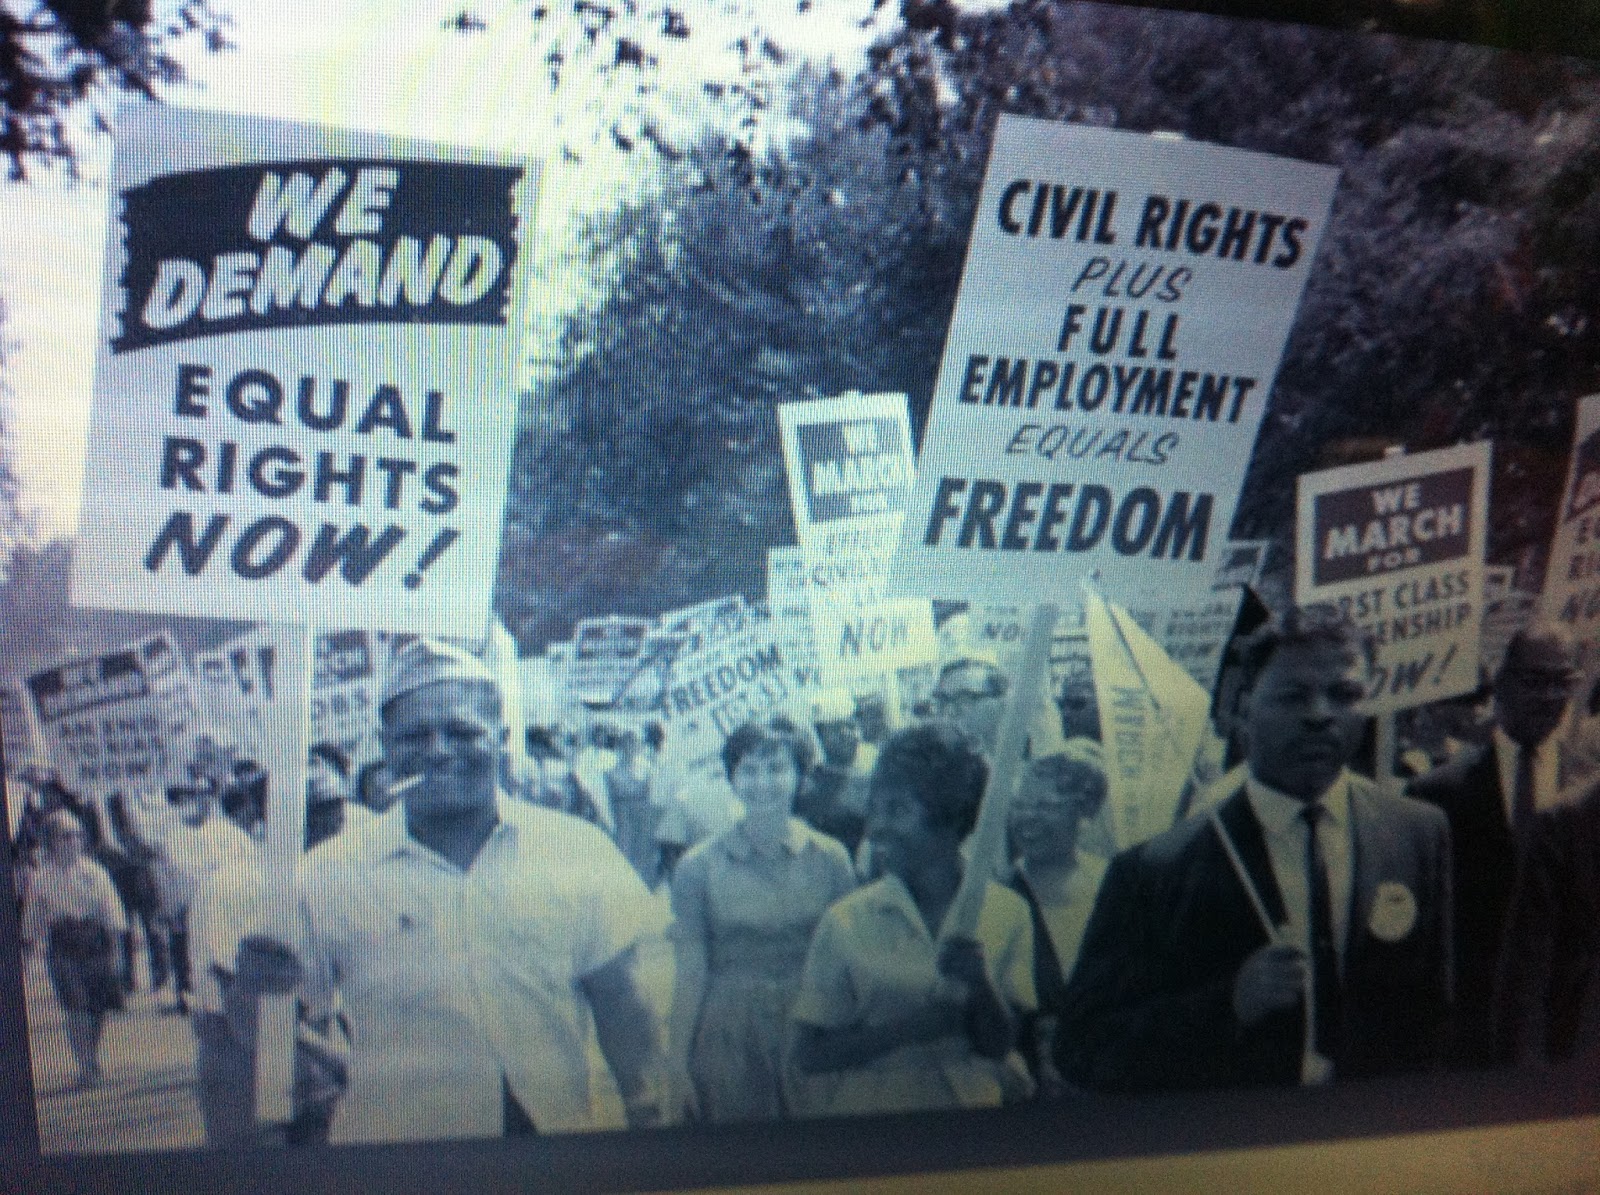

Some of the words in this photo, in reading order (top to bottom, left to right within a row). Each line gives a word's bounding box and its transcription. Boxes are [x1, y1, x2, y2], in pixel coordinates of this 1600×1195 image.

[247, 166, 399, 242] WE
[997, 178, 1119, 245] CIVIL
[1136, 194, 1310, 270] RIGHTS
[141, 233, 503, 331] DEMAND
[1071, 256, 1193, 302] PLUS
[1056, 303, 1180, 360] FULL
[172, 362, 456, 445] EQUAL
[958, 354, 1259, 424] EMPLOYMENT
[160, 435, 462, 516] RIGHTS
[1005, 423, 1180, 465] EQUALS
[923, 476, 1215, 562] FREEDOM
[1323, 504, 1462, 560] MARCH
[1371, 483, 1421, 514] WE
[143, 510, 462, 590] NOW!
[1366, 549, 1421, 571] FOR
[1394, 570, 1470, 609] CLASS
